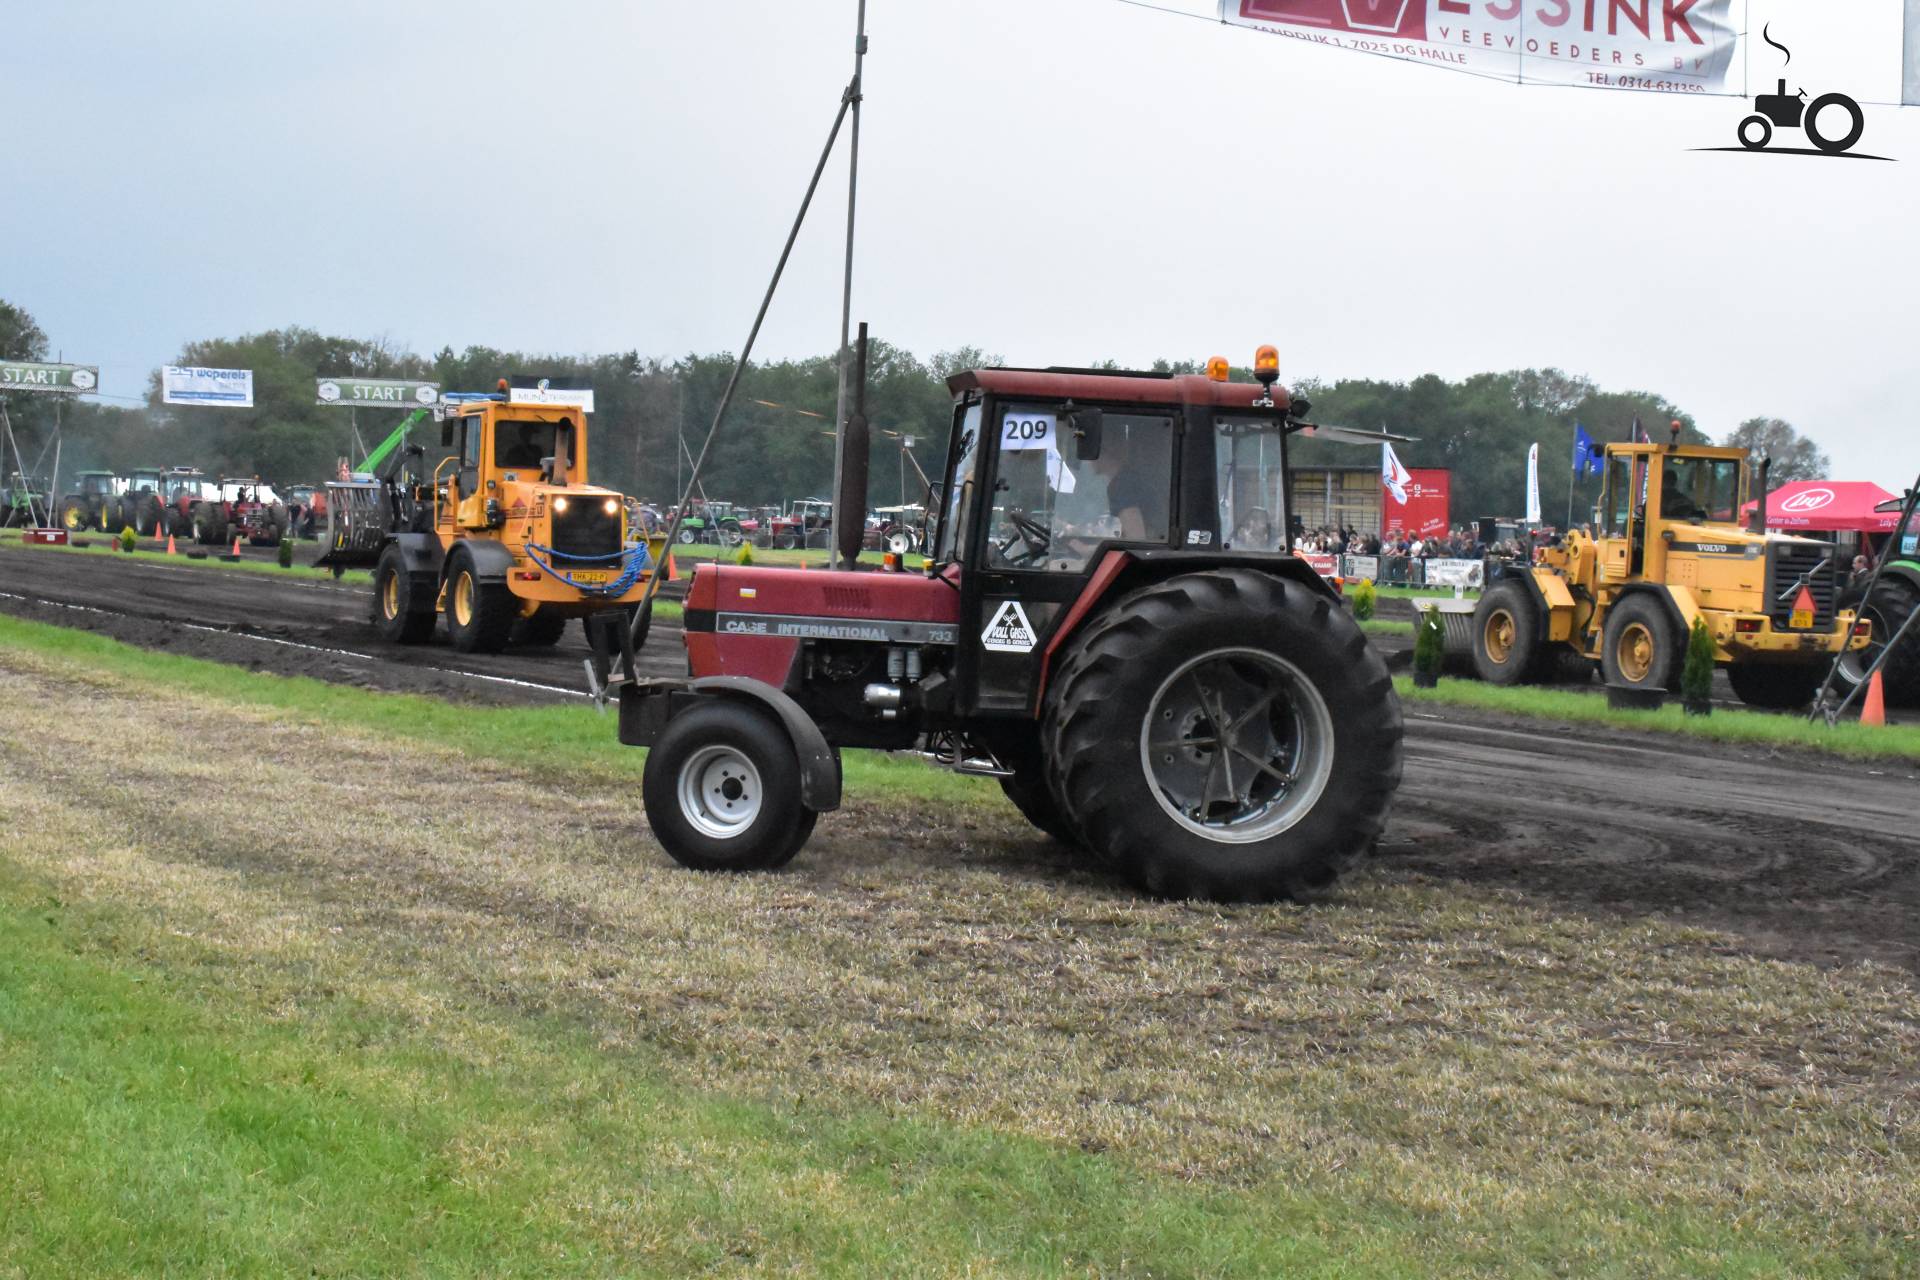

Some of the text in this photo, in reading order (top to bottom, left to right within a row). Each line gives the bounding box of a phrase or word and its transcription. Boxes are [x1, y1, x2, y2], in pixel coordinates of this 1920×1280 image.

[1352, 39, 1390, 53] 7025
[1393, 44, 1416, 56] DG
[1420, 47, 1468, 65] HALLE
[1440, 26, 1644, 65] VEEVOEDERS
[1586, 72, 1615, 86] TEL.
[3, 367, 61, 385] START
[353, 385, 407, 401] START
[1005, 420, 1048, 440] 209
[1696, 543, 1728, 553] VOLVO
[725, 620, 953, 641] CASE INTERNATIONAL 733
